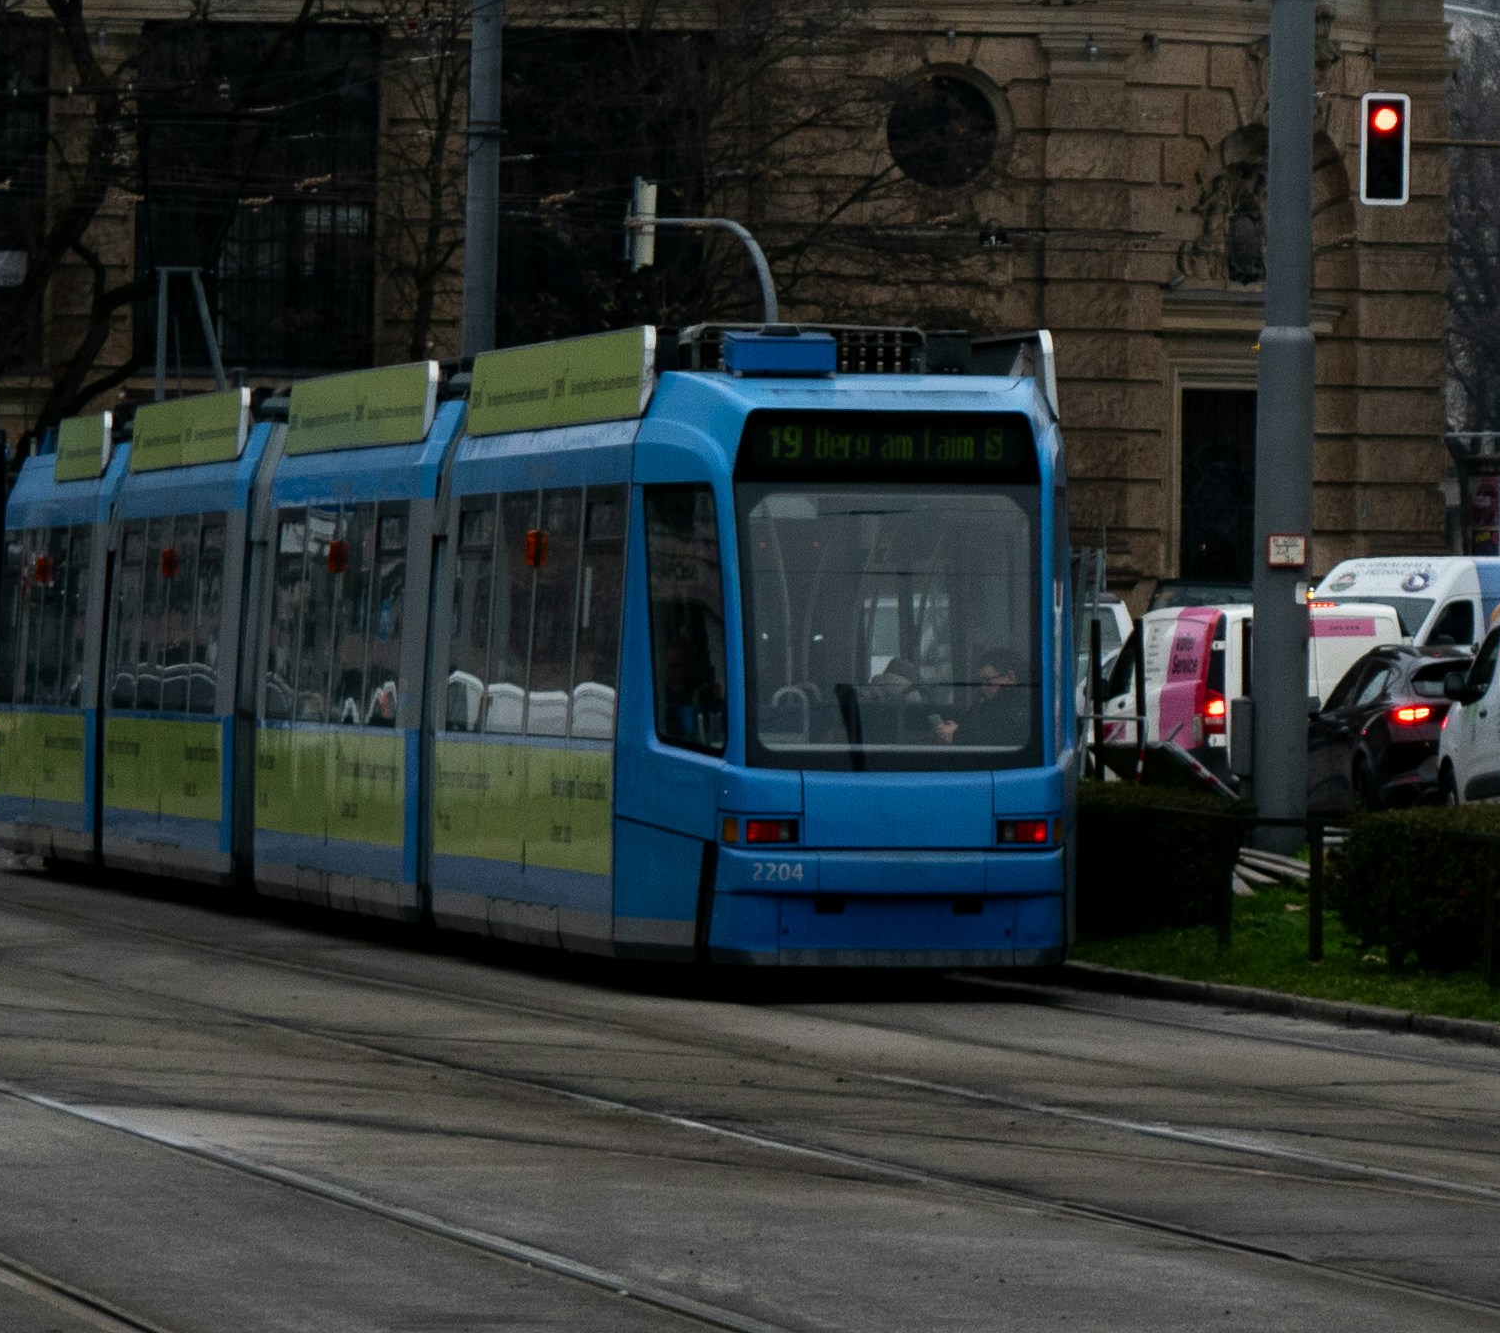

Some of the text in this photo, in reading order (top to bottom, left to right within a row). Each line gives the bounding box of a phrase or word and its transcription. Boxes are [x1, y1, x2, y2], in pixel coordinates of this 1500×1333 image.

[769, 424, 802, 460] 19
[813, 425, 871, 460] Berg
[880, 433, 914, 460] am
[922, 426, 976, 460] Laim
[751, 861, 804, 883] 2204
